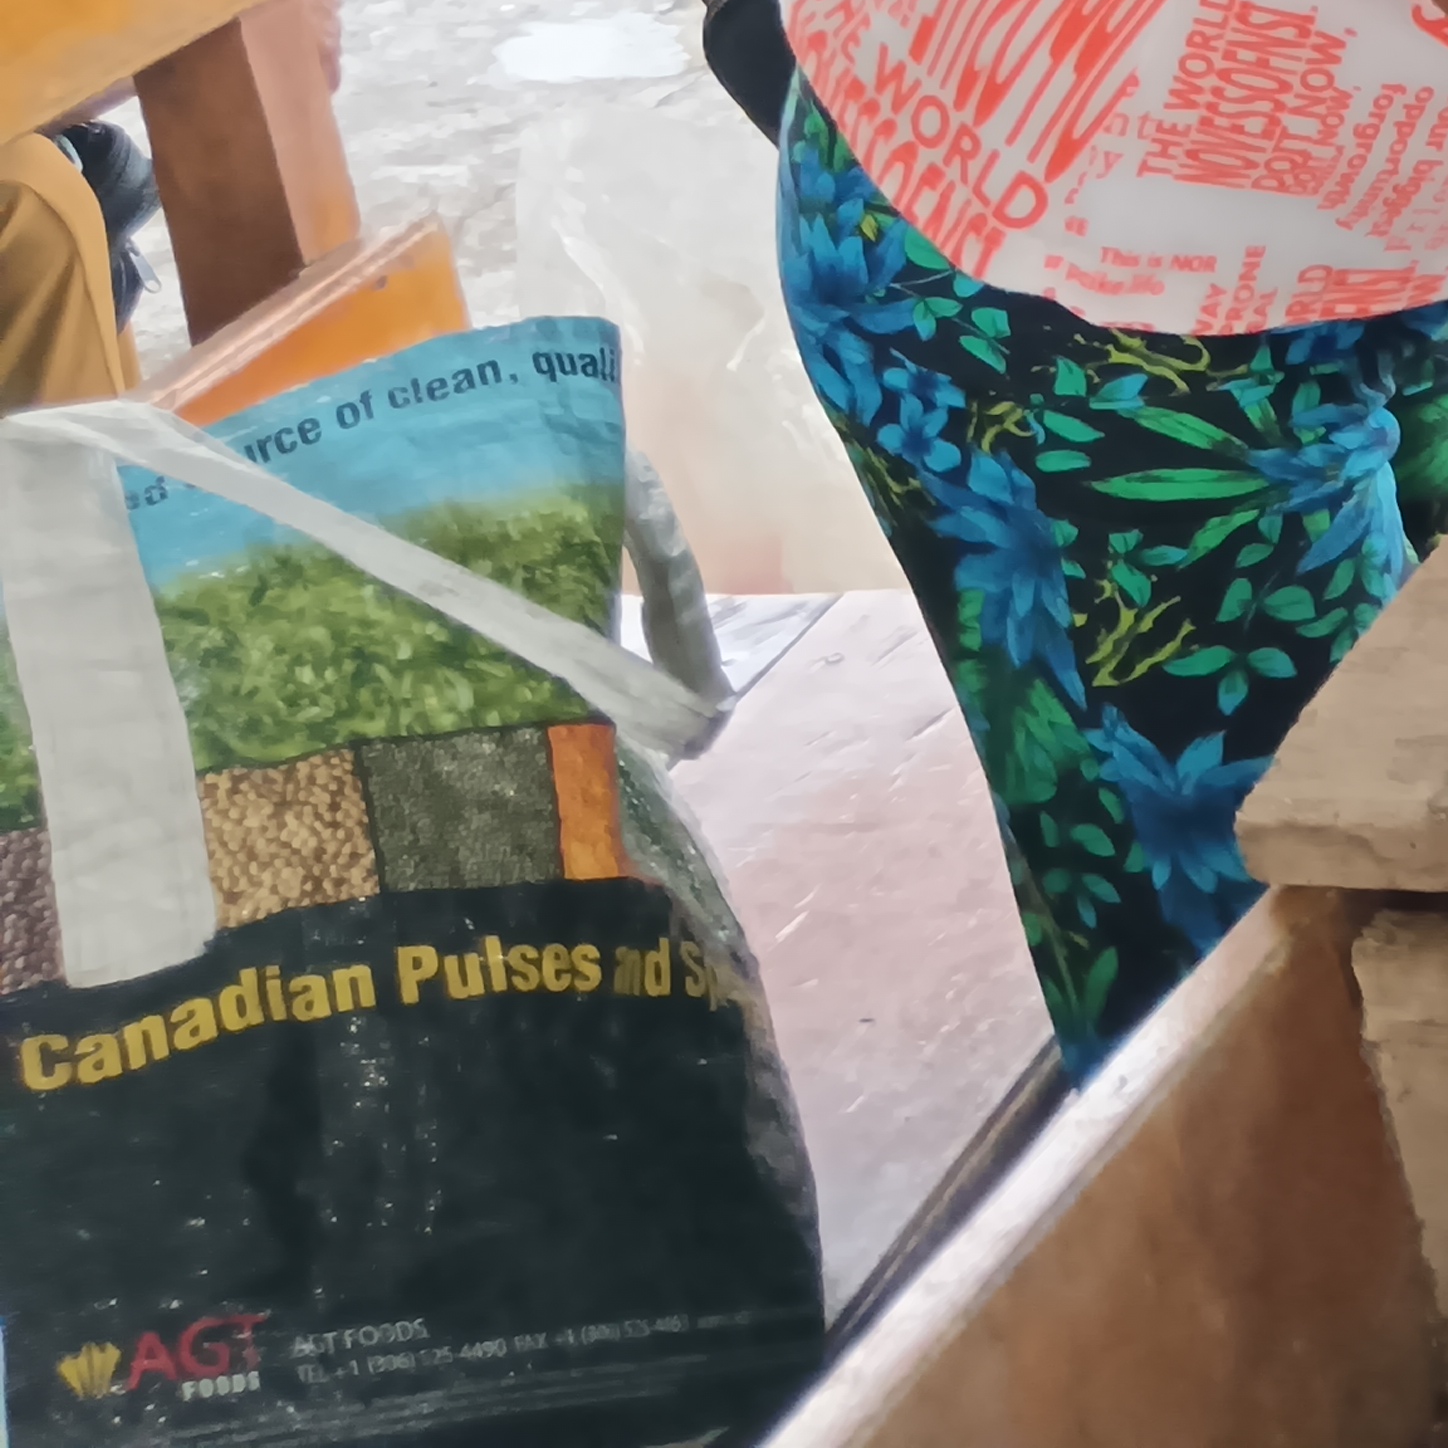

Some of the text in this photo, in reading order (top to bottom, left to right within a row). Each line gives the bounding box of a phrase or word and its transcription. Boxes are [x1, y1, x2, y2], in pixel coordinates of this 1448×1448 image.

[874, 42, 1049, 230] WORLD
[1136, 118, 1191, 179] THE
[243, 411, 324, 464] urce
[335, 385, 375, 432] of
[386, 356, 519, 412] clean,
[20, 962, 377, 1093] Canadian
[397, 934, 603, 1005] Pulses
[125, 1309, 271, 1393] AGT
[342, 1316, 431, 1351] FOODS
[181, 1370, 262, 1402] FOODS
